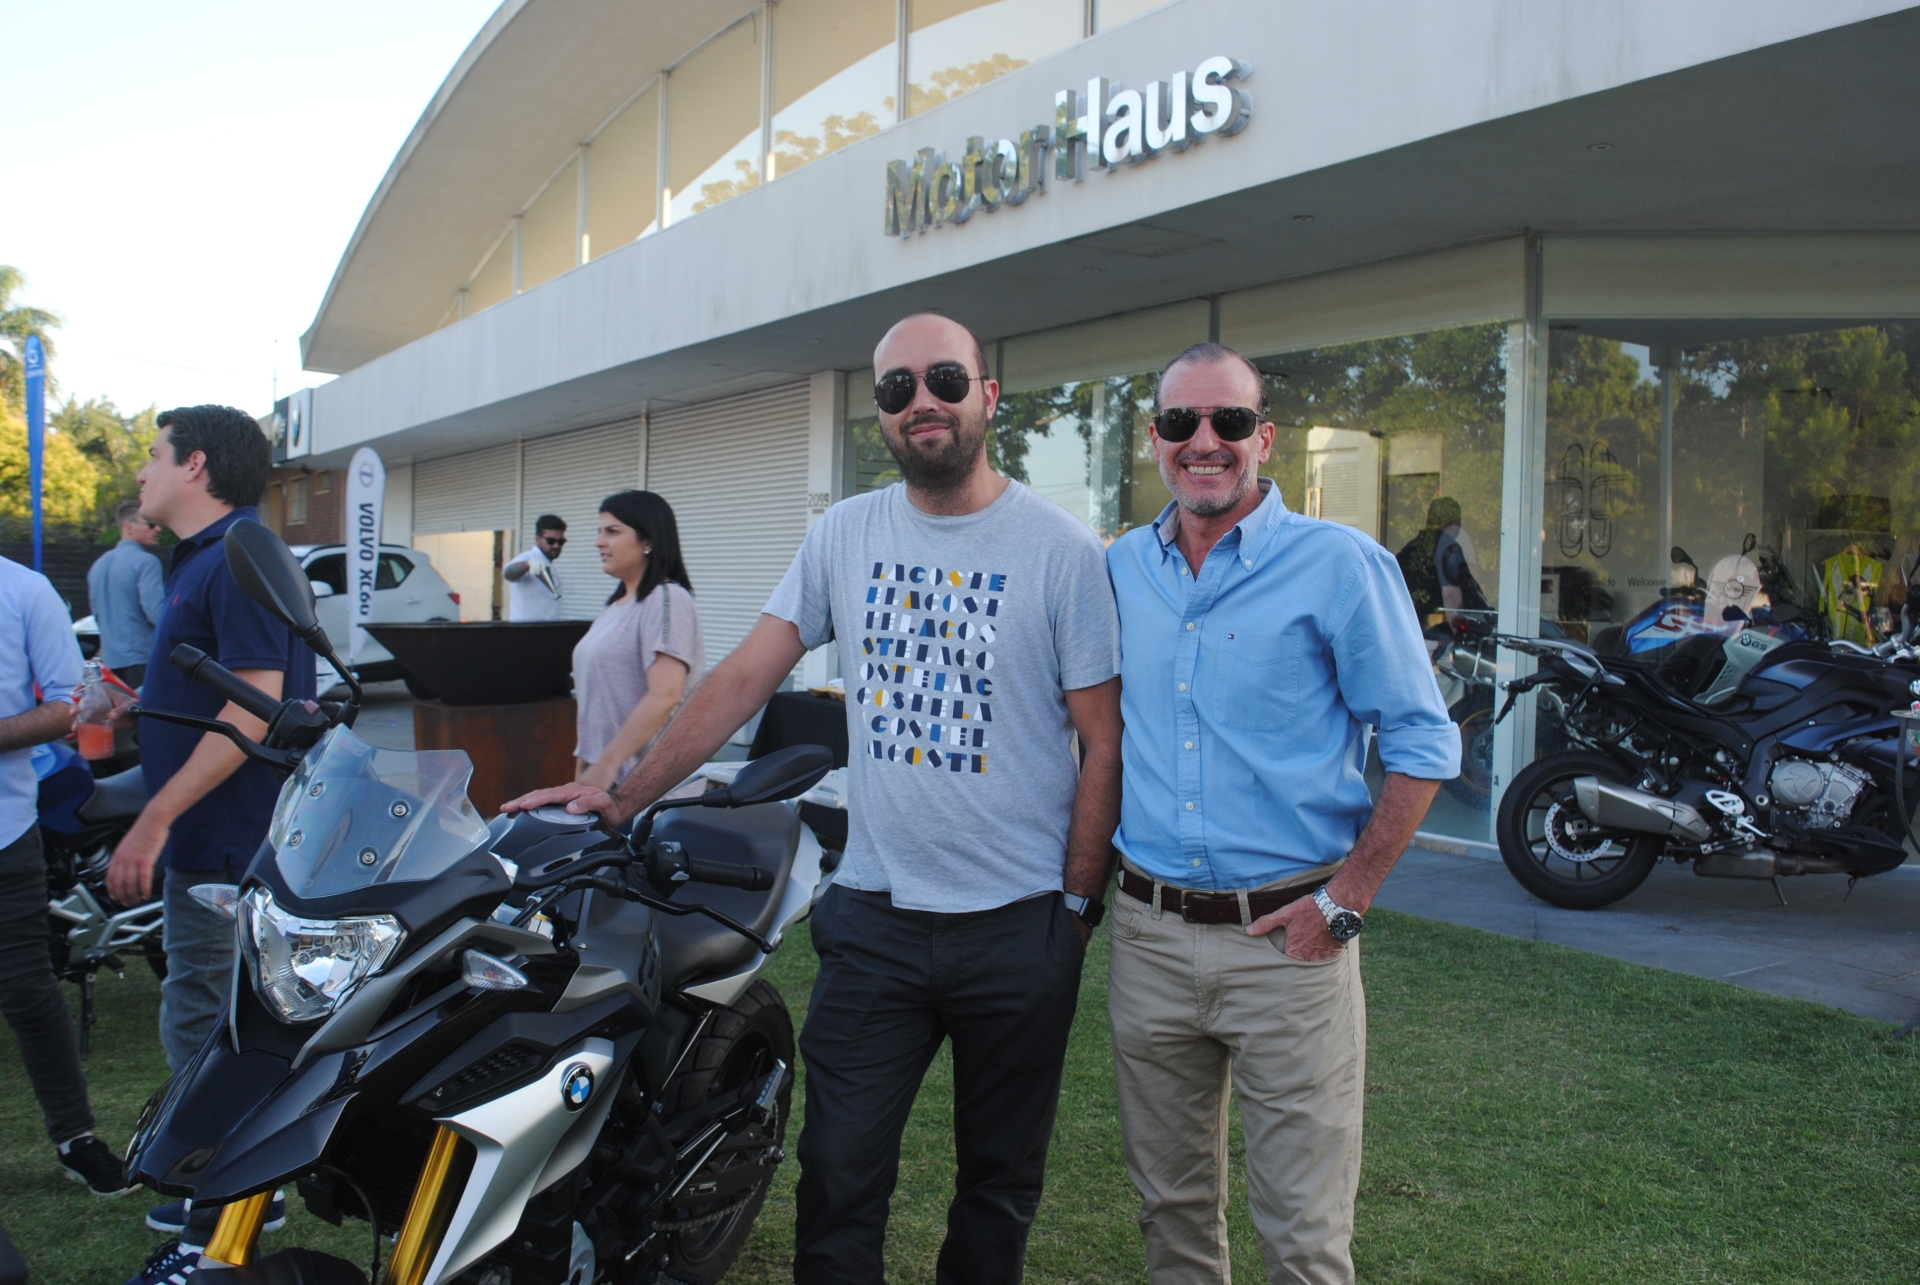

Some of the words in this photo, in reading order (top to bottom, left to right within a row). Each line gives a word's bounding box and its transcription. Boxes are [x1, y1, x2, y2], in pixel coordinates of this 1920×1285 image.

[885, 56, 1252, 237] MotorHaus
[359, 503, 374, 561] VOLVO
[872, 562, 1007, 592] LACOSTE
[1627, 577, 1667, 587] Welcome
[866, 586, 1003, 617] ELACOST
[864, 611, 997, 643] TELACOS
[863, 637, 995, 671] STELACO
[860, 662, 993, 696] OSTELAC
[857, 687, 992, 722] COSTELA
